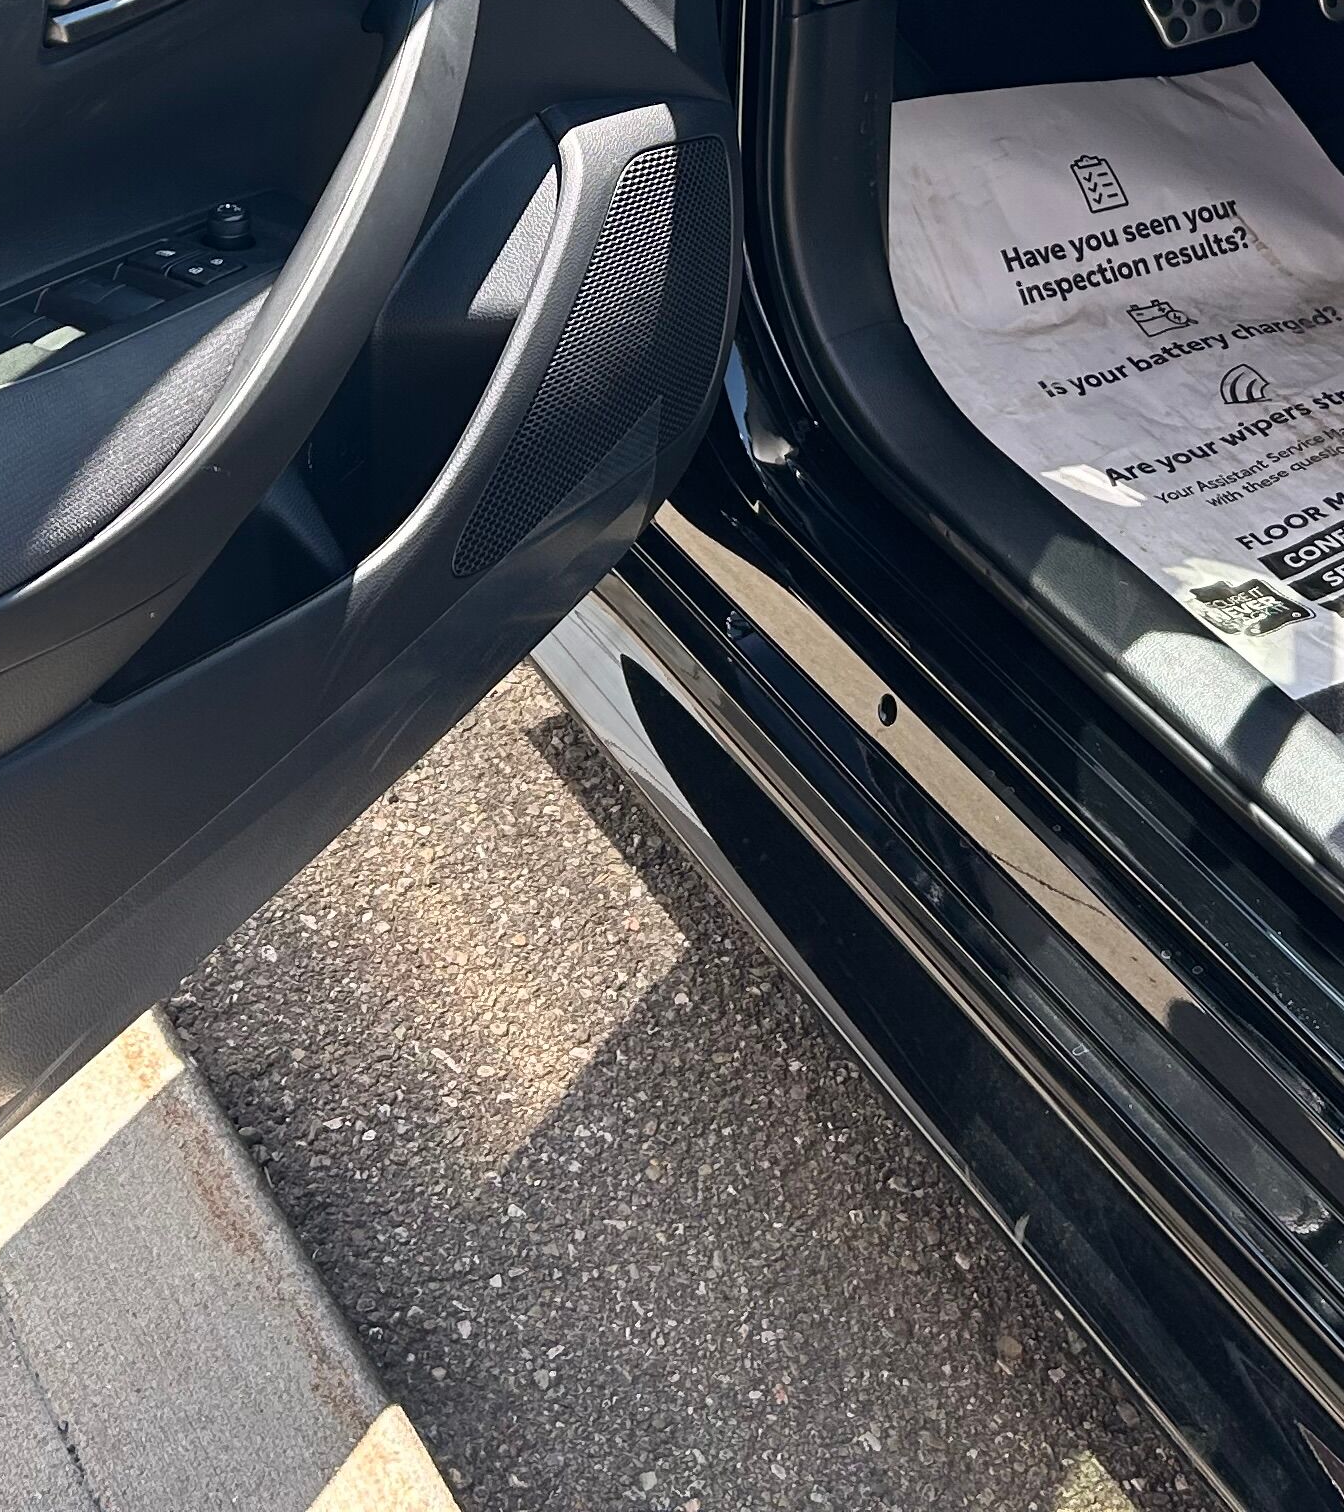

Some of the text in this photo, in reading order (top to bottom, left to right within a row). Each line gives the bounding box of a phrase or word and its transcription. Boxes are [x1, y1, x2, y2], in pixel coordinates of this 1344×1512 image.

[1001, 199, 1237, 272] Have you seen your
[1016, 226, 1250, 306] inspection results?
[1037, 305, 1344, 398] Is your battery charged?
[1106, 461, 1157, 487] Are
[1155, 440, 1219, 474] your
[1219, 402, 1312, 447] wipers
[1153, 485, 1196, 504] Your
[1196, 459, 1270, 492] Assistant
[1266, 434, 1325, 463] Service
[1206, 489, 1244, 507] with
[1242, 470, 1290, 494] these
[1235, 506, 1329, 550] FLOOR
[1247, 586, 1263, 598] IT
